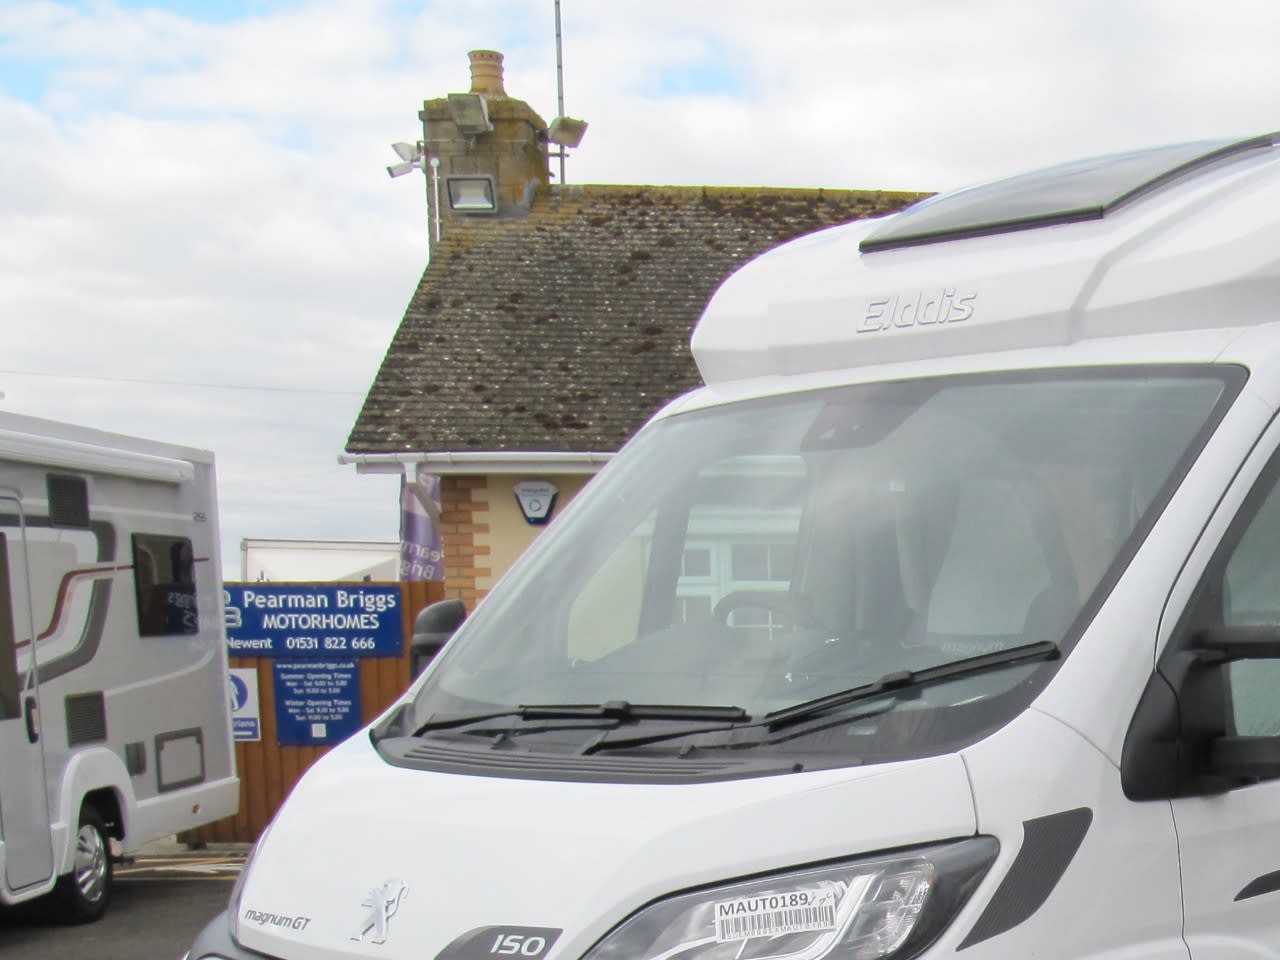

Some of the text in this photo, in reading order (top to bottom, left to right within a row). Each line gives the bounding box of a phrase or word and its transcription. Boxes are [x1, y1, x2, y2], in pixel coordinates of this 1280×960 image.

[856, 287, 977, 333] Elddis
[243, 590, 329, 608] Pearman
[337, 590, 397, 612] Briggs
[263, 613, 380, 630] MOTORHOMES
[226, 637, 376, 649] Newent 01531 822 666
[720, 892, 808, 917] MAUT0189
[490, 934, 546, 956] 150
